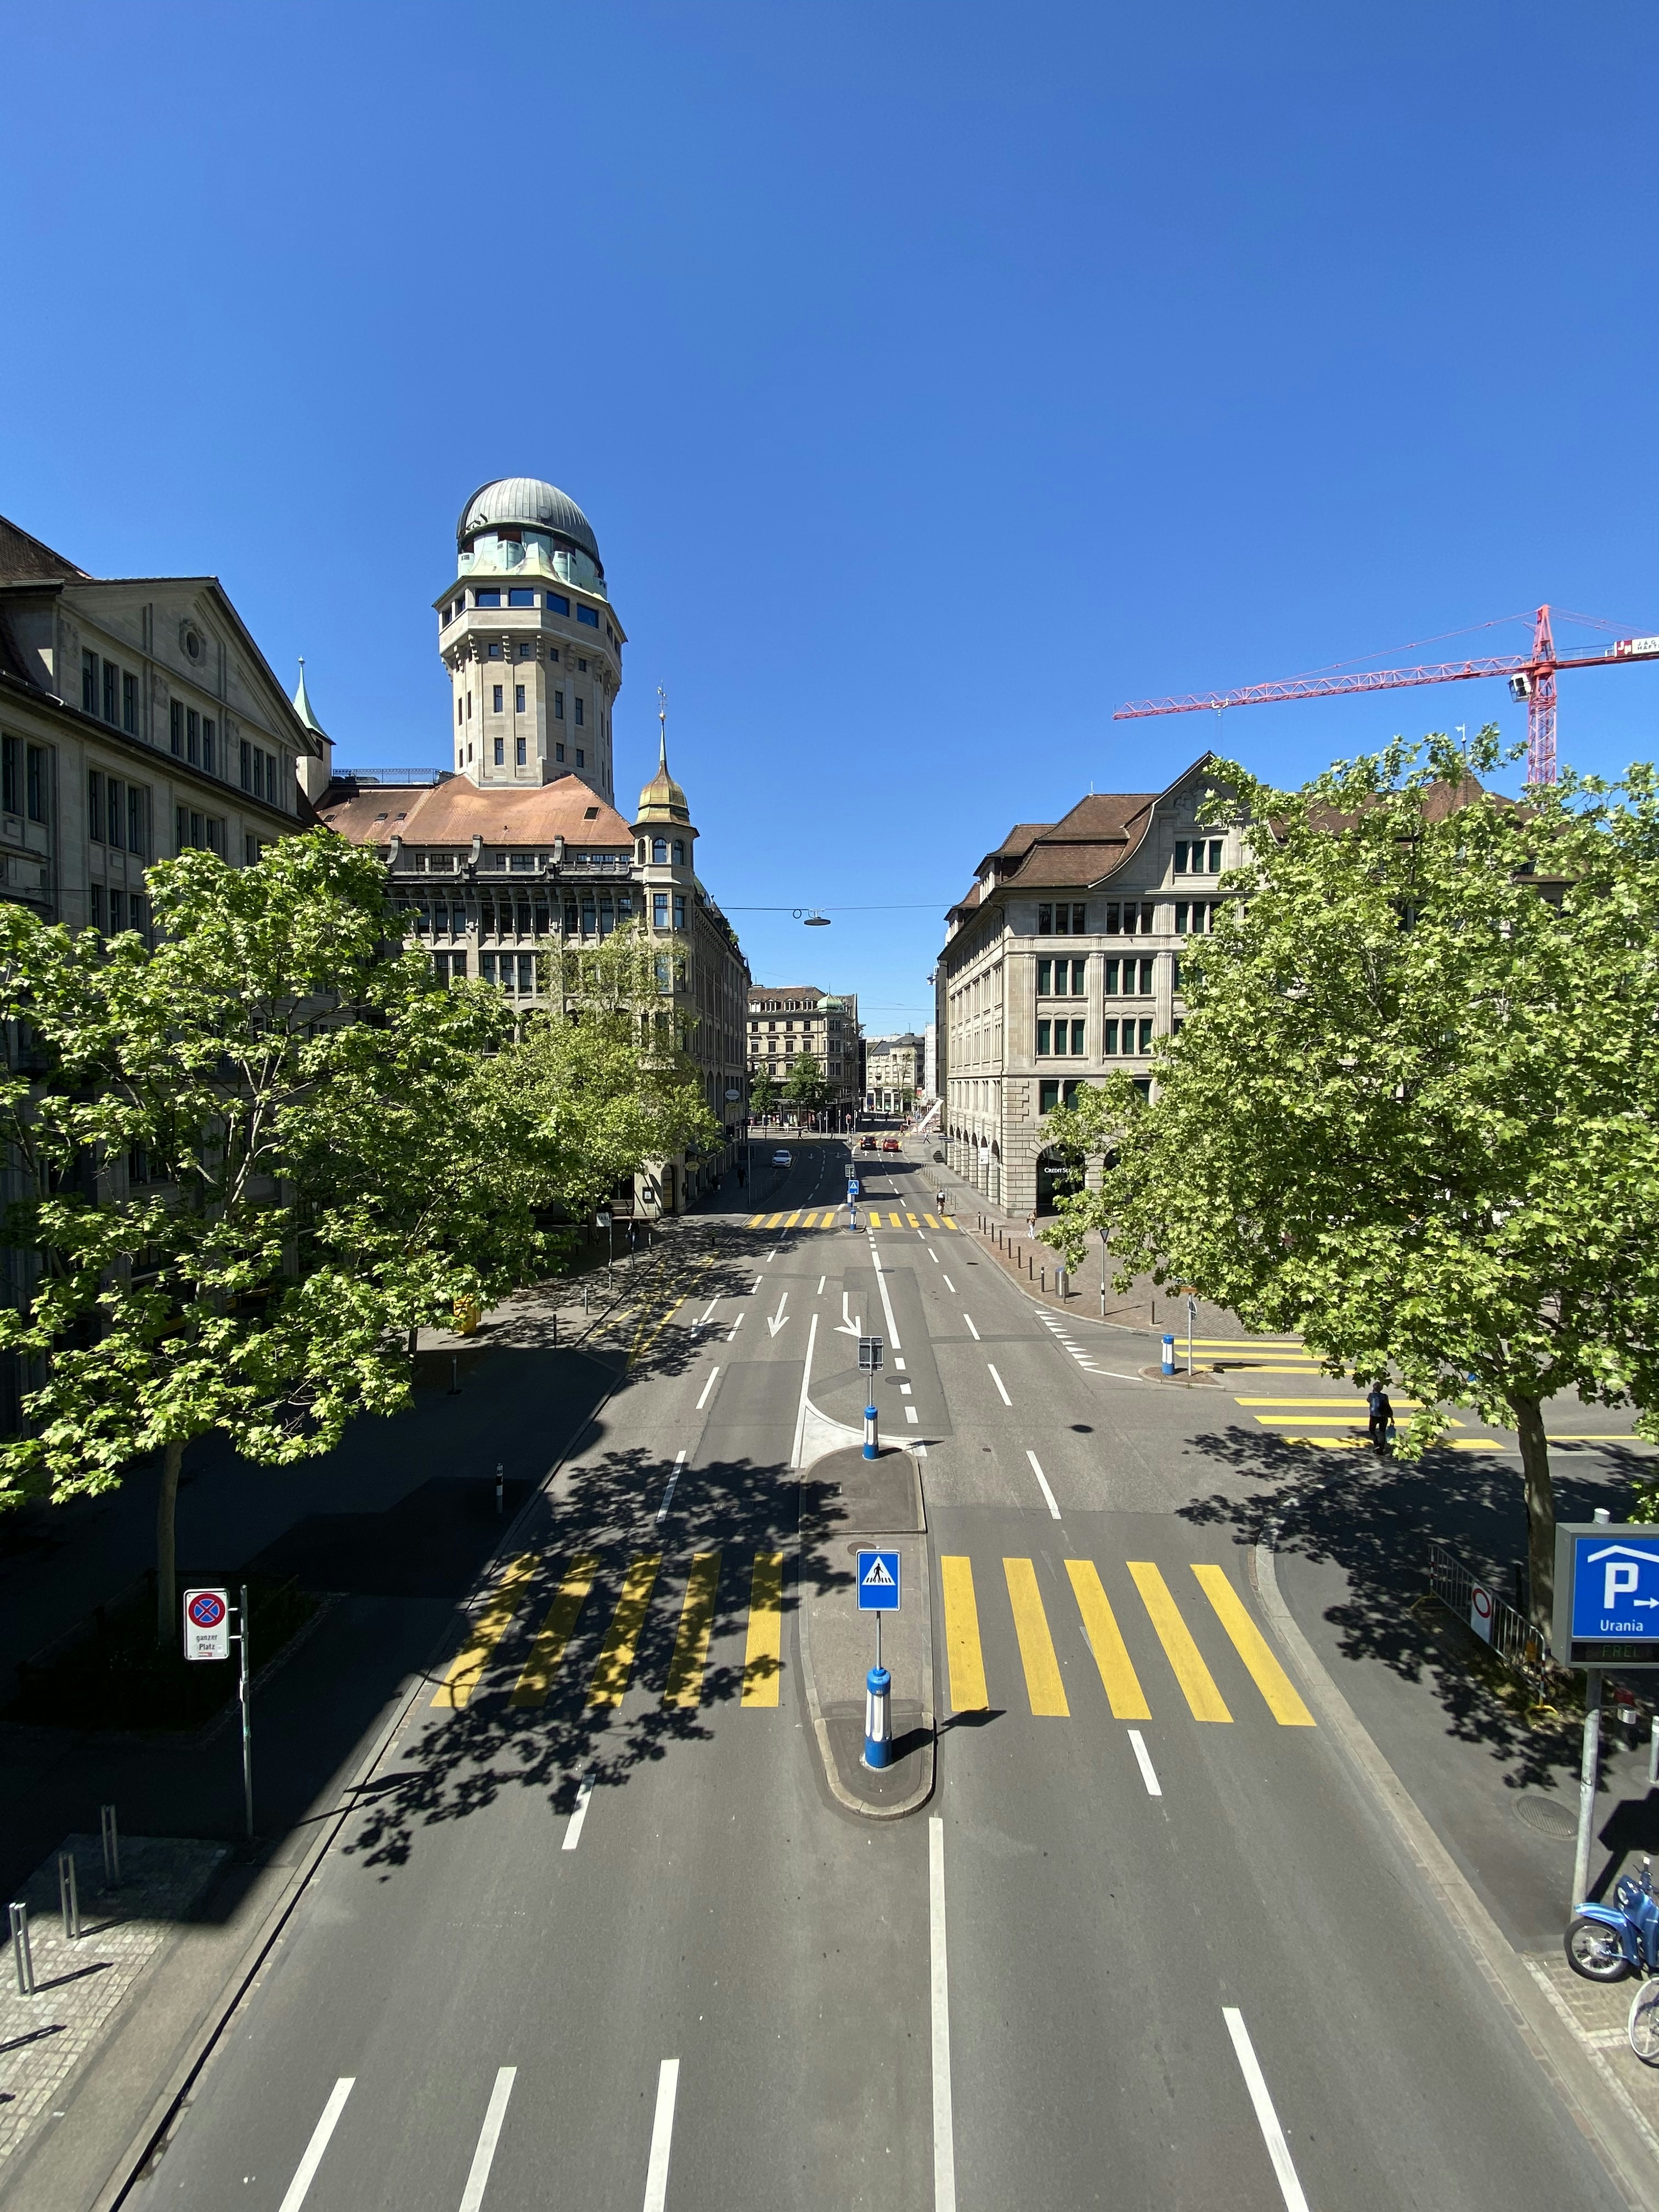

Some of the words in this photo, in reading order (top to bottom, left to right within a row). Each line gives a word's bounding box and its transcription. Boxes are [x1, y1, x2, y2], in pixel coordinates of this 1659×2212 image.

[1603, 1562, 1639, 1609] P
[1600, 1619, 1644, 1632] Urania
[196, 1634, 218, 1643] ganzer
[1602, 1645, 1637, 1657] FREI
